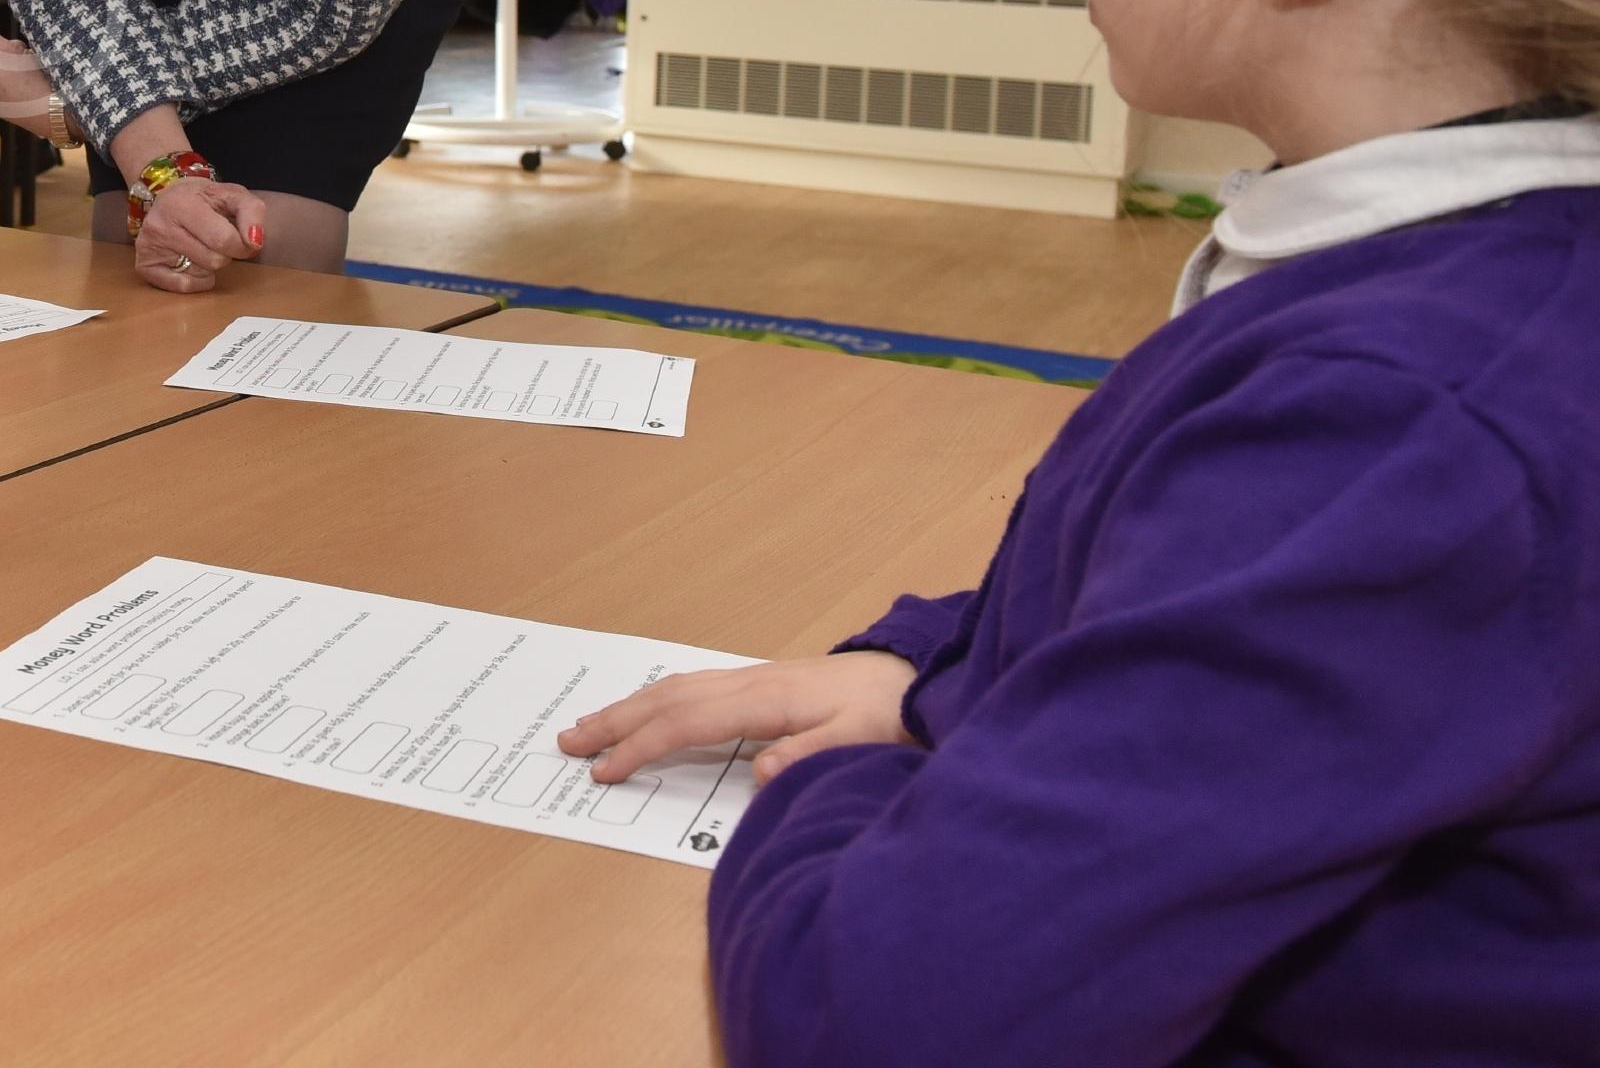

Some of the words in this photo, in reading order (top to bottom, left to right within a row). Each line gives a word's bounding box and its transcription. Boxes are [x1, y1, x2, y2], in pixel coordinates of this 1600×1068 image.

[206, 356, 234, 371] Money
[221, 345, 243, 358] Word
[233, 331, 262, 348] Problems
[665, 313, 892, 351] Caterpillar
[17, 647, 75, 675] Money
[60, 621, 106, 646] Word
[96, 590, 158, 622] Problems
